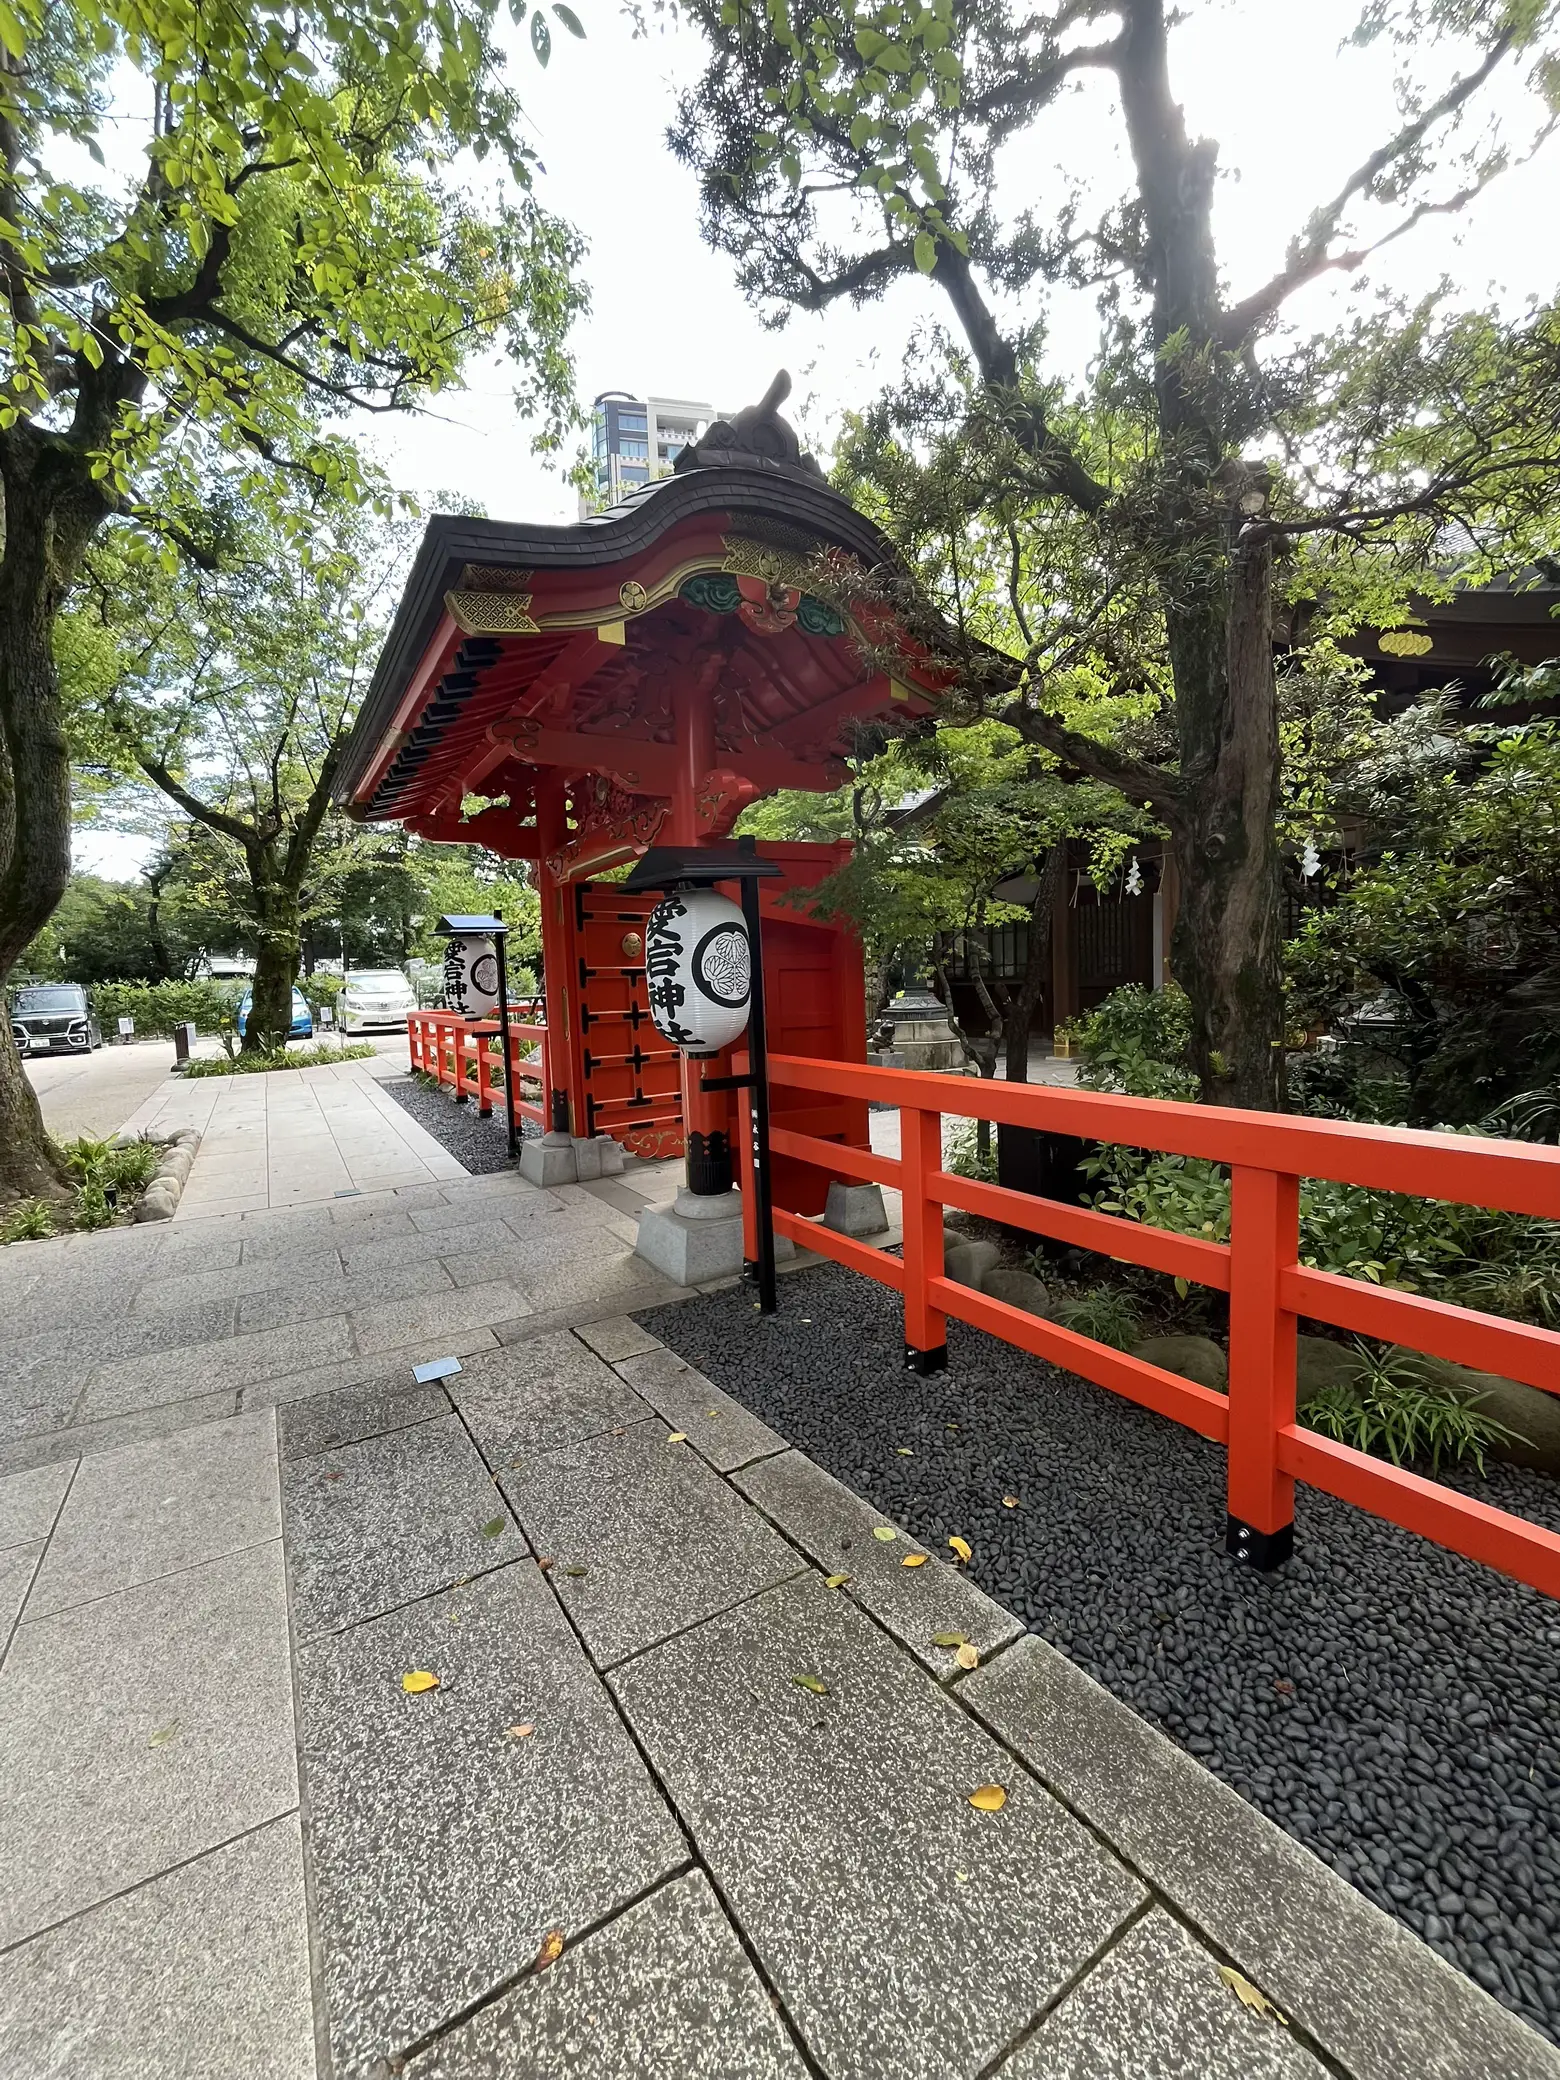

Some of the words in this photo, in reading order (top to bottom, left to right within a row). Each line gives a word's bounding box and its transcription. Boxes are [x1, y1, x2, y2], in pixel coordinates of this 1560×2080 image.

[444, 940, 476, 1015] 愛宕神社
[647, 896, 706, 1045] 愛宕神社
